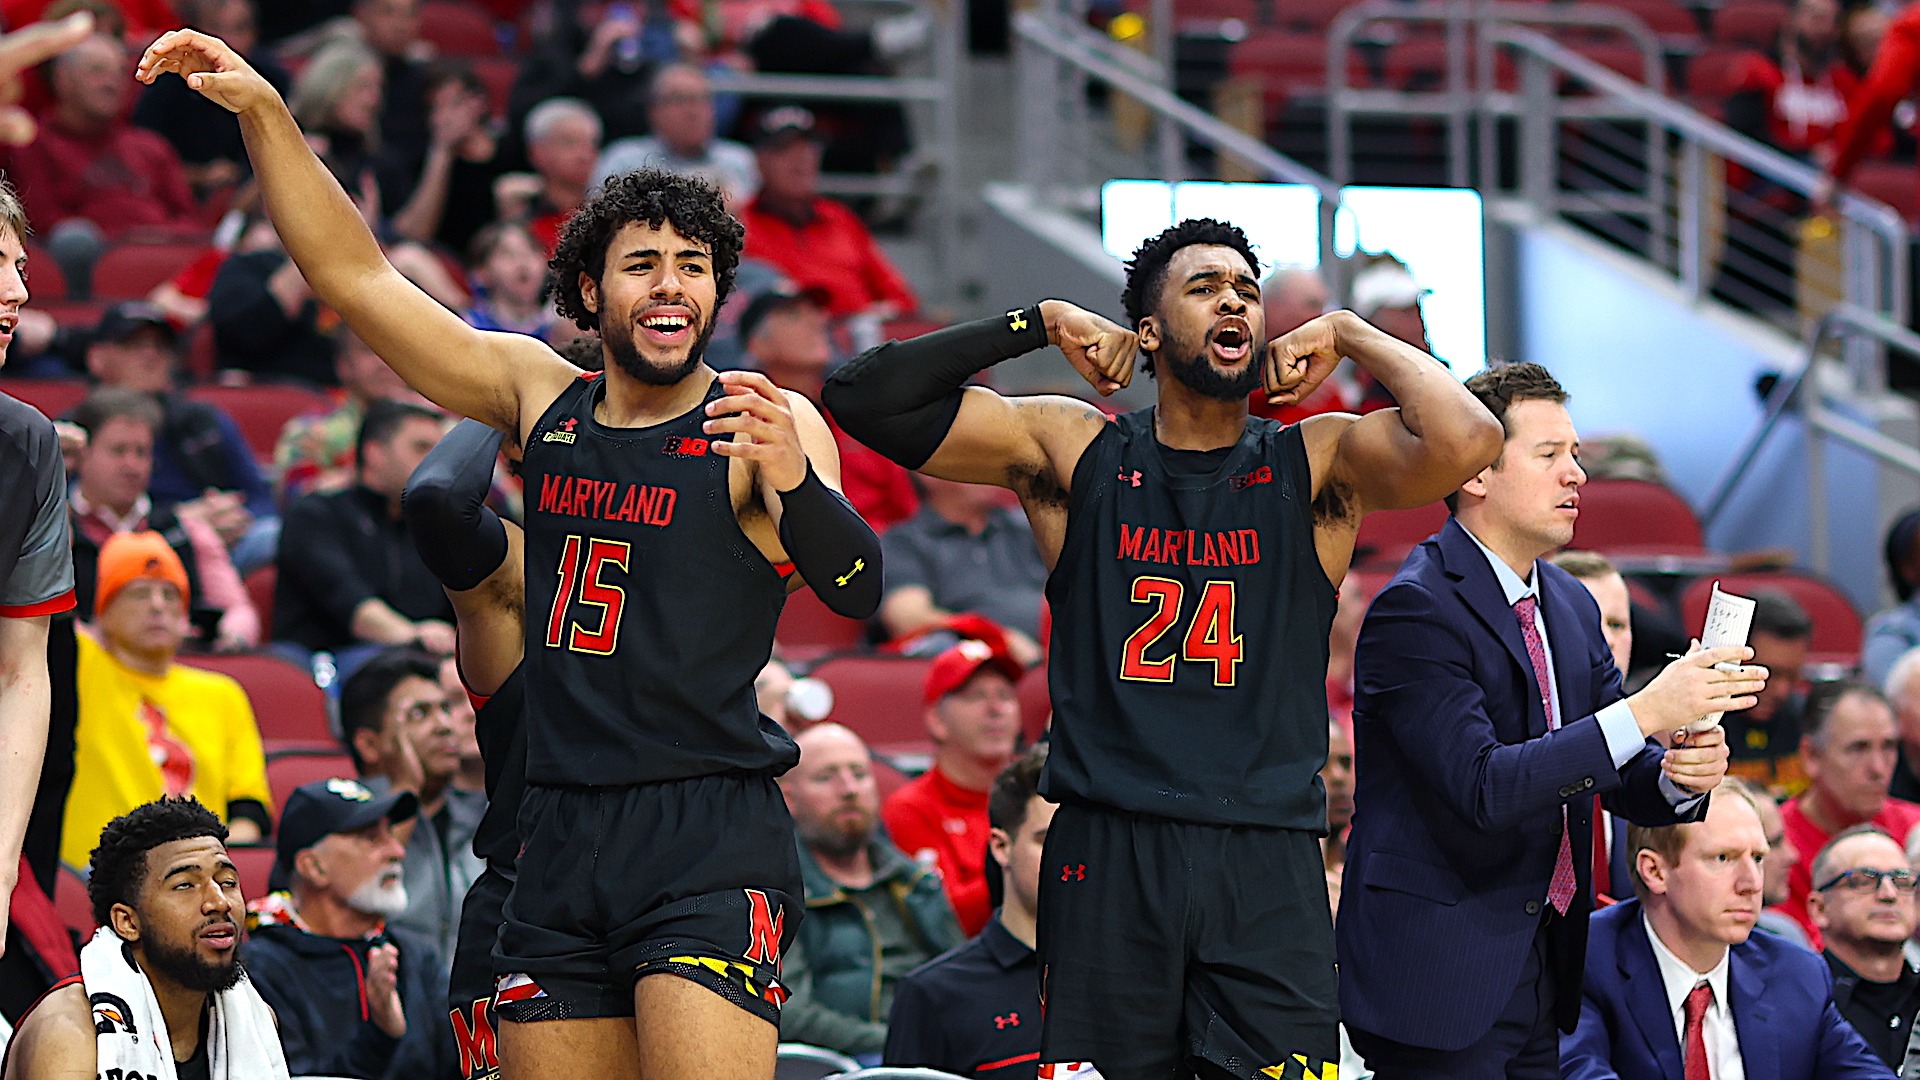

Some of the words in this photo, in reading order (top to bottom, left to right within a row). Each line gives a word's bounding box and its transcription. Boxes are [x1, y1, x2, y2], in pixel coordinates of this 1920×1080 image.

[538, 473, 678, 528] MARYLAND
[1117, 523, 1261, 567] MARLAND
[546, 534, 631, 656] 15
[1119, 575, 1244, 687] 24
[449, 996, 500, 1080] M
